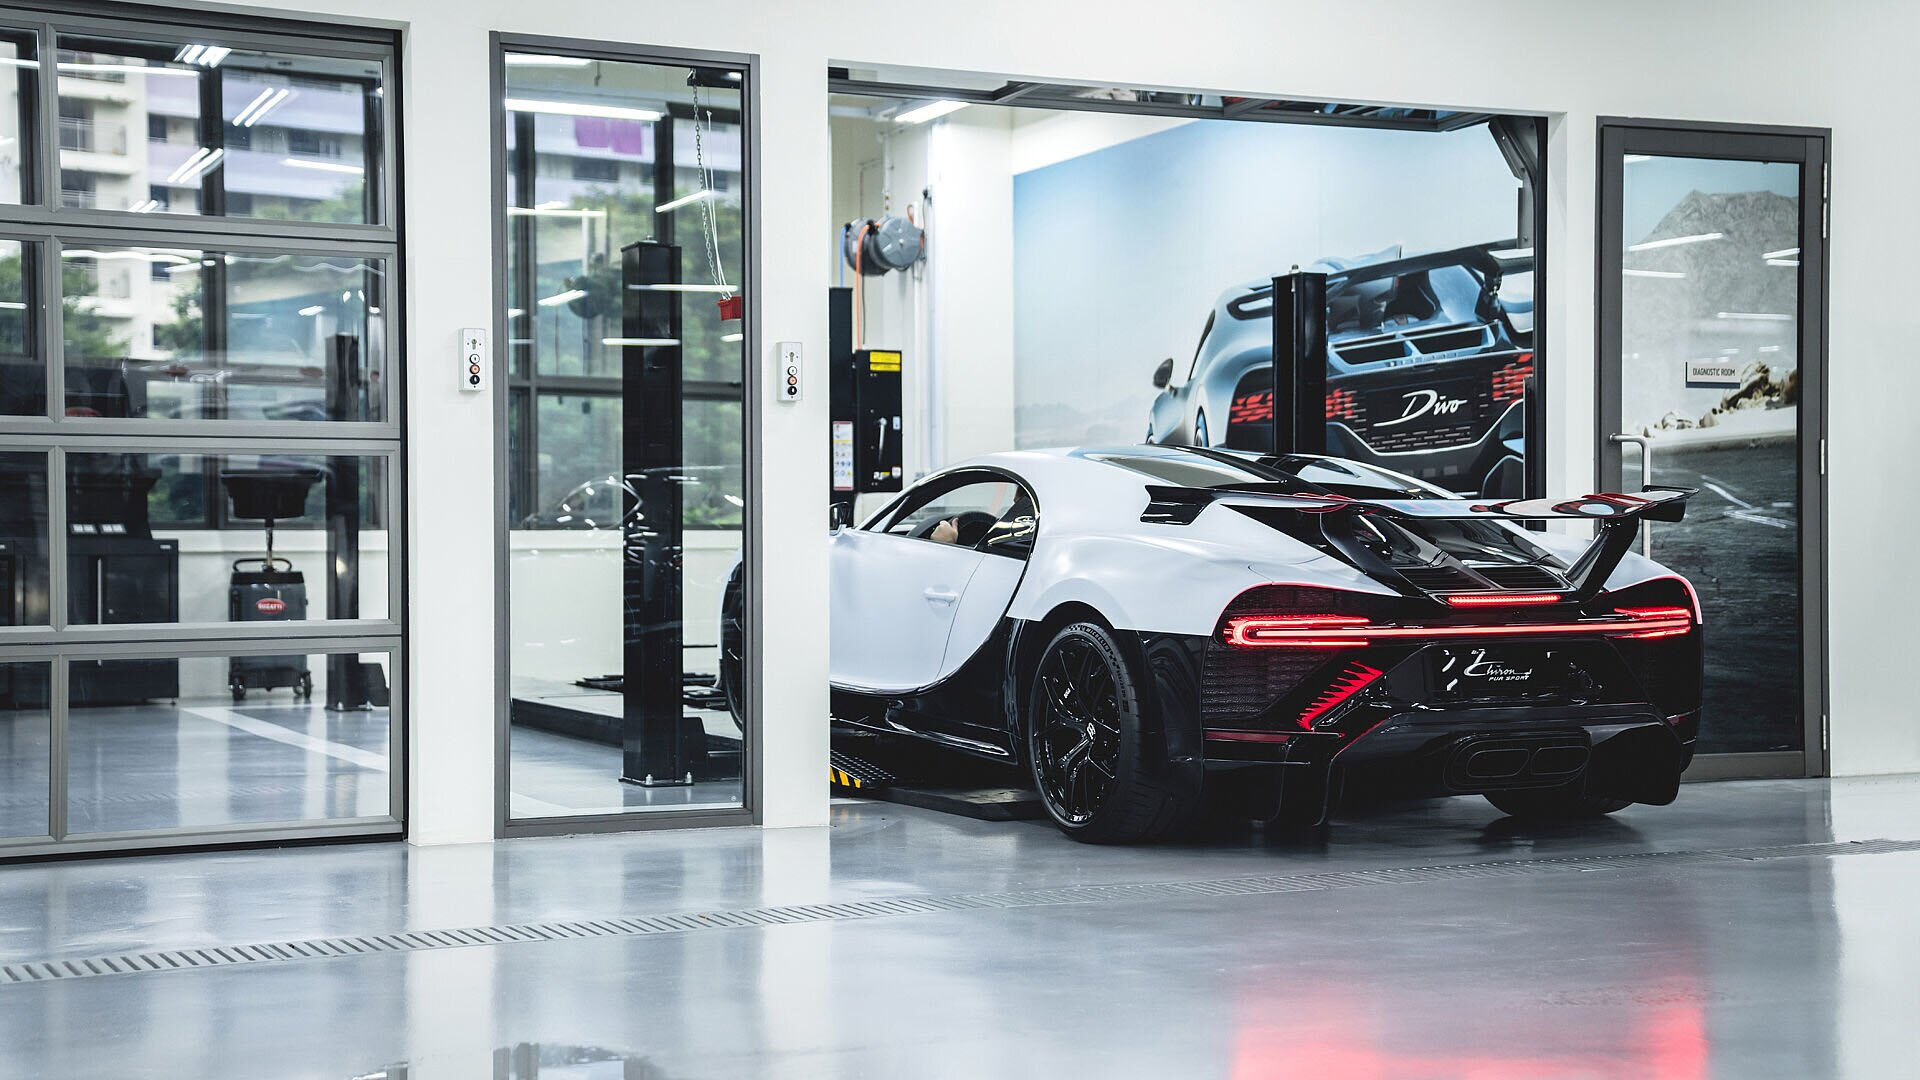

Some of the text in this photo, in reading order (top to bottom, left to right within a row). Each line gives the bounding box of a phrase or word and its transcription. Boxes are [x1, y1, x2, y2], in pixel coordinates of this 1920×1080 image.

[1692, 367, 1736, 377] DIAGNOSTIC ROOM
[1373, 389, 1467, 427] Divo
[1463, 661, 1533, 677] Chiron
